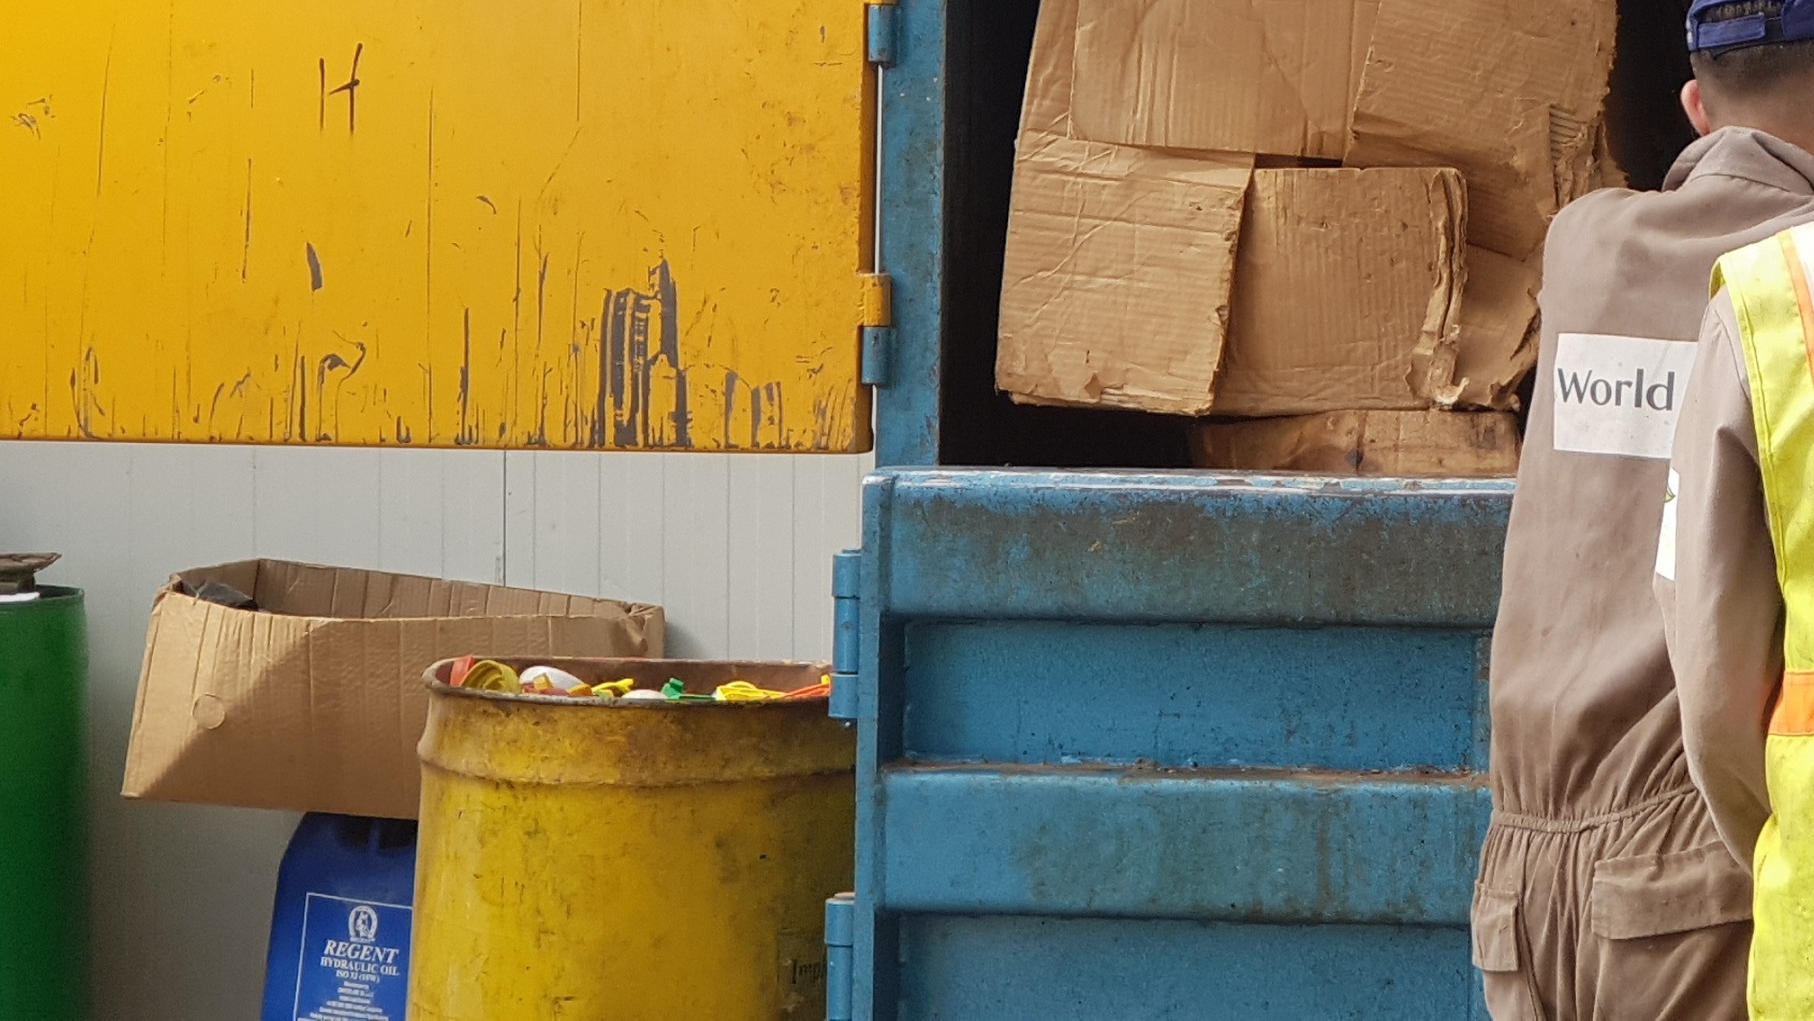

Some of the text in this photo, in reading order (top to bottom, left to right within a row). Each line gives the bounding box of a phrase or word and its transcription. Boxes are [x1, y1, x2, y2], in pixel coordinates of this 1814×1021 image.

[1557, 367, 1676, 412] World
[324, 939, 399, 964] REGENT
[320, 957, 400, 976] HYDRAULIC OIL
